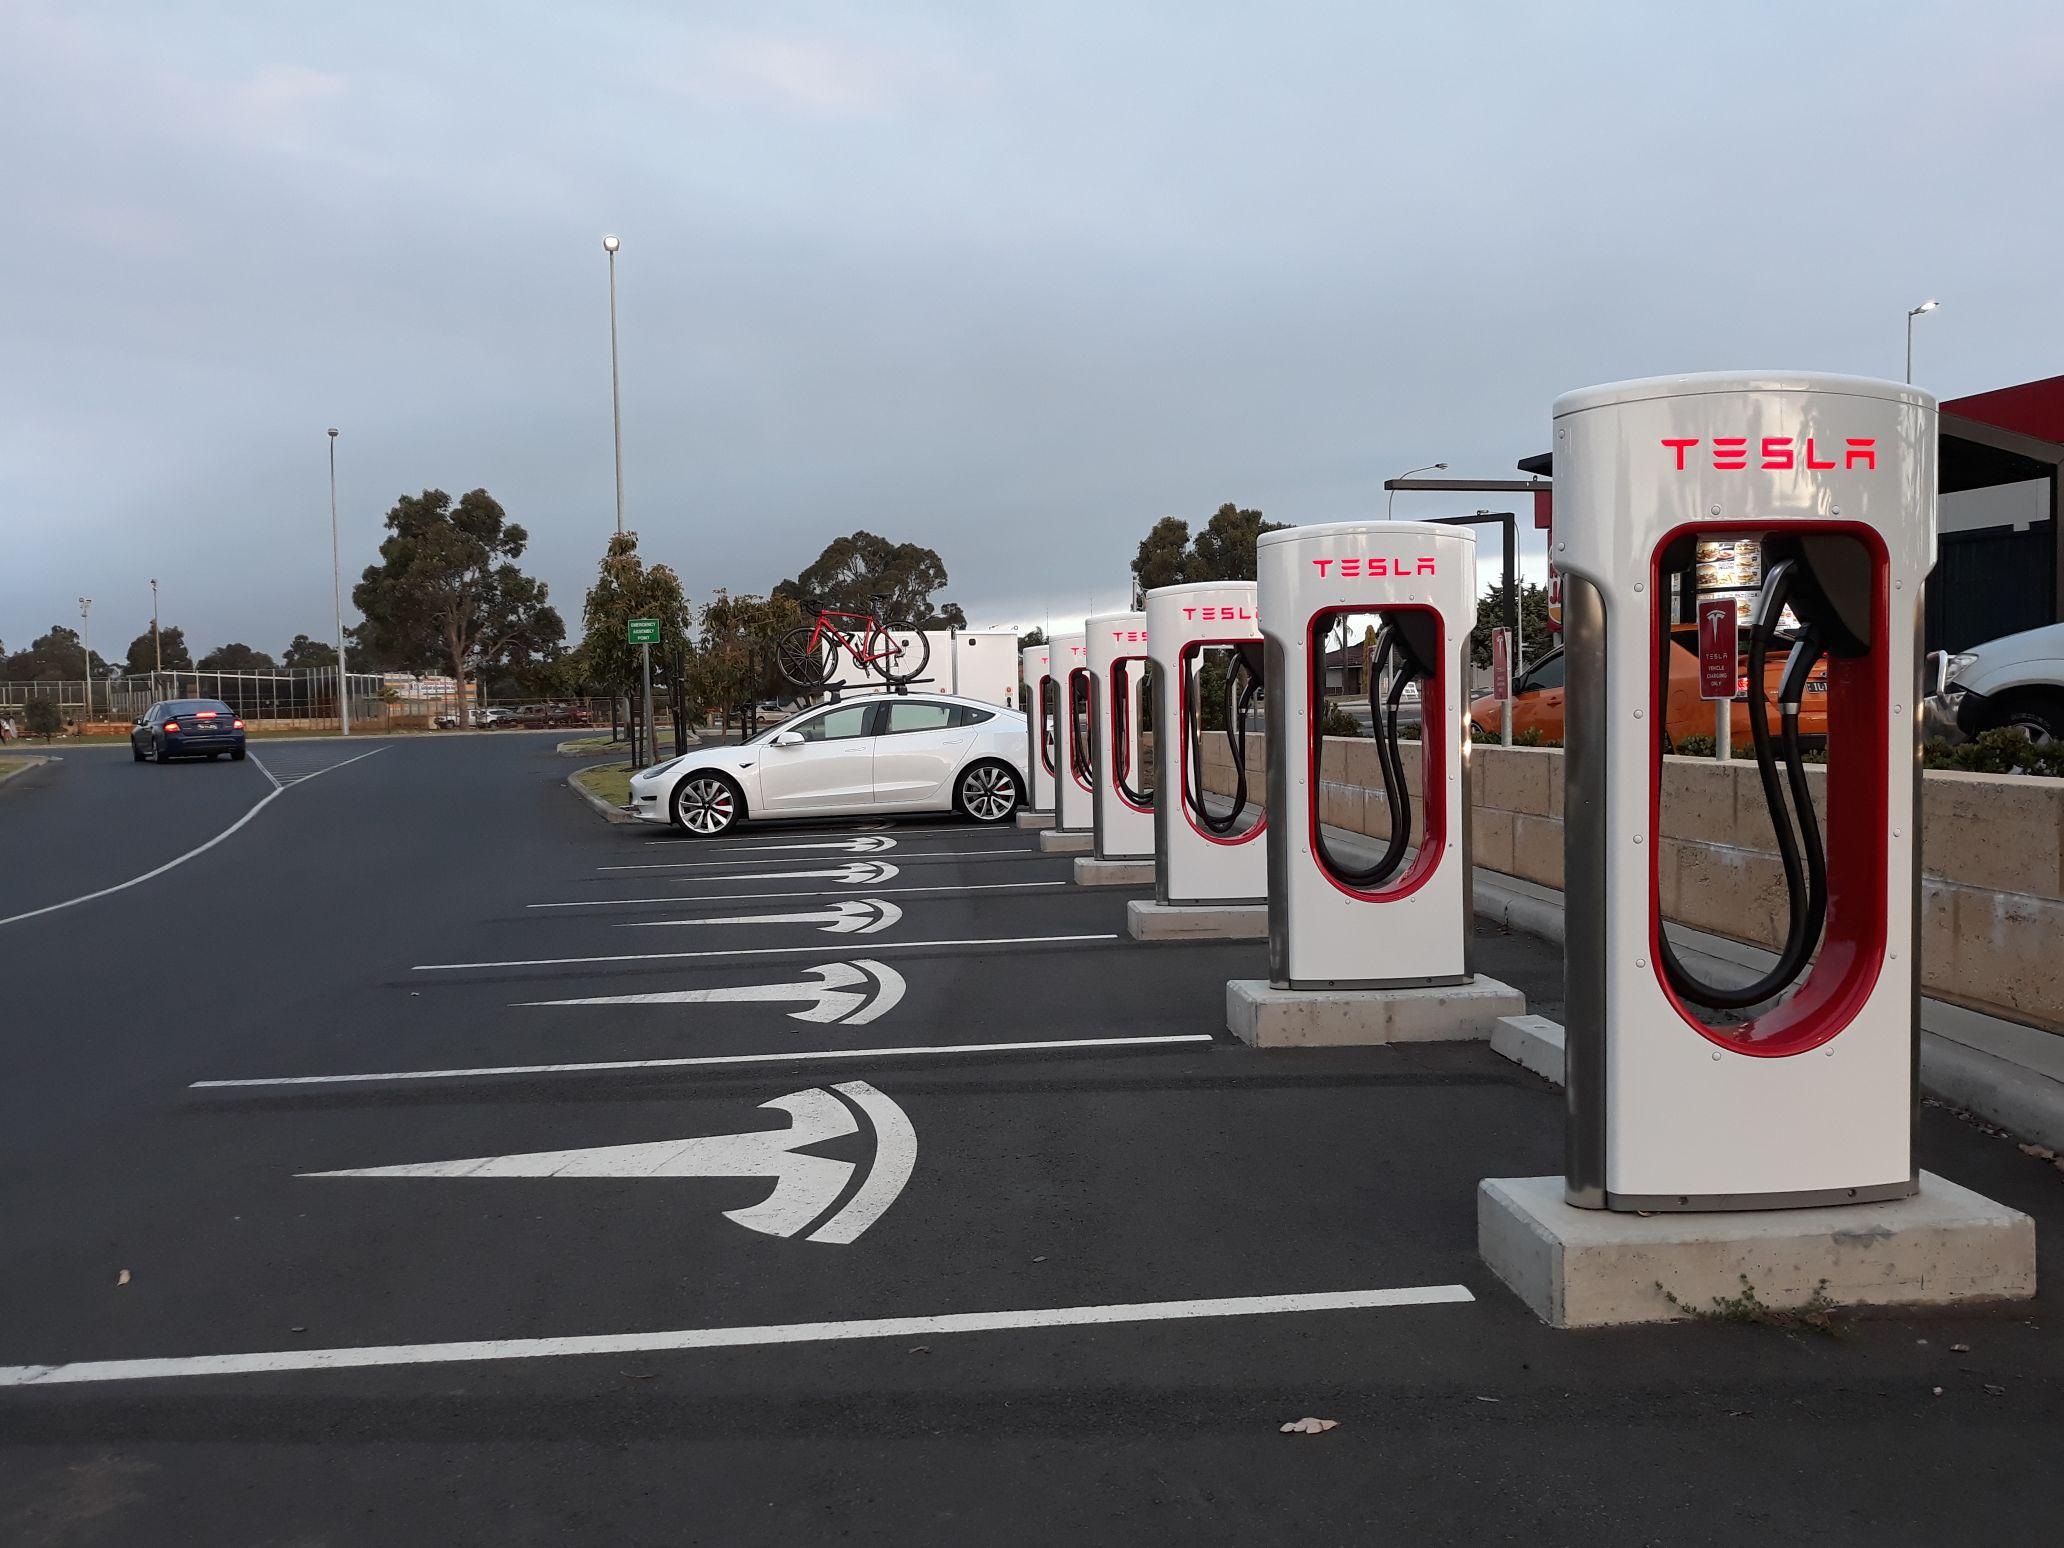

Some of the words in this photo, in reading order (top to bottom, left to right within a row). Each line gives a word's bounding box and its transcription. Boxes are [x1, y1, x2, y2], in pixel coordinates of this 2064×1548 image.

[1661, 437, 1876, 471] TESLA
[1312, 557, 1436, 578] TESLA
[1182, 606, 1259, 621] TESL
[1112, 631, 1148, 642] TES
[1705, 652, 1728, 660] TESLA
